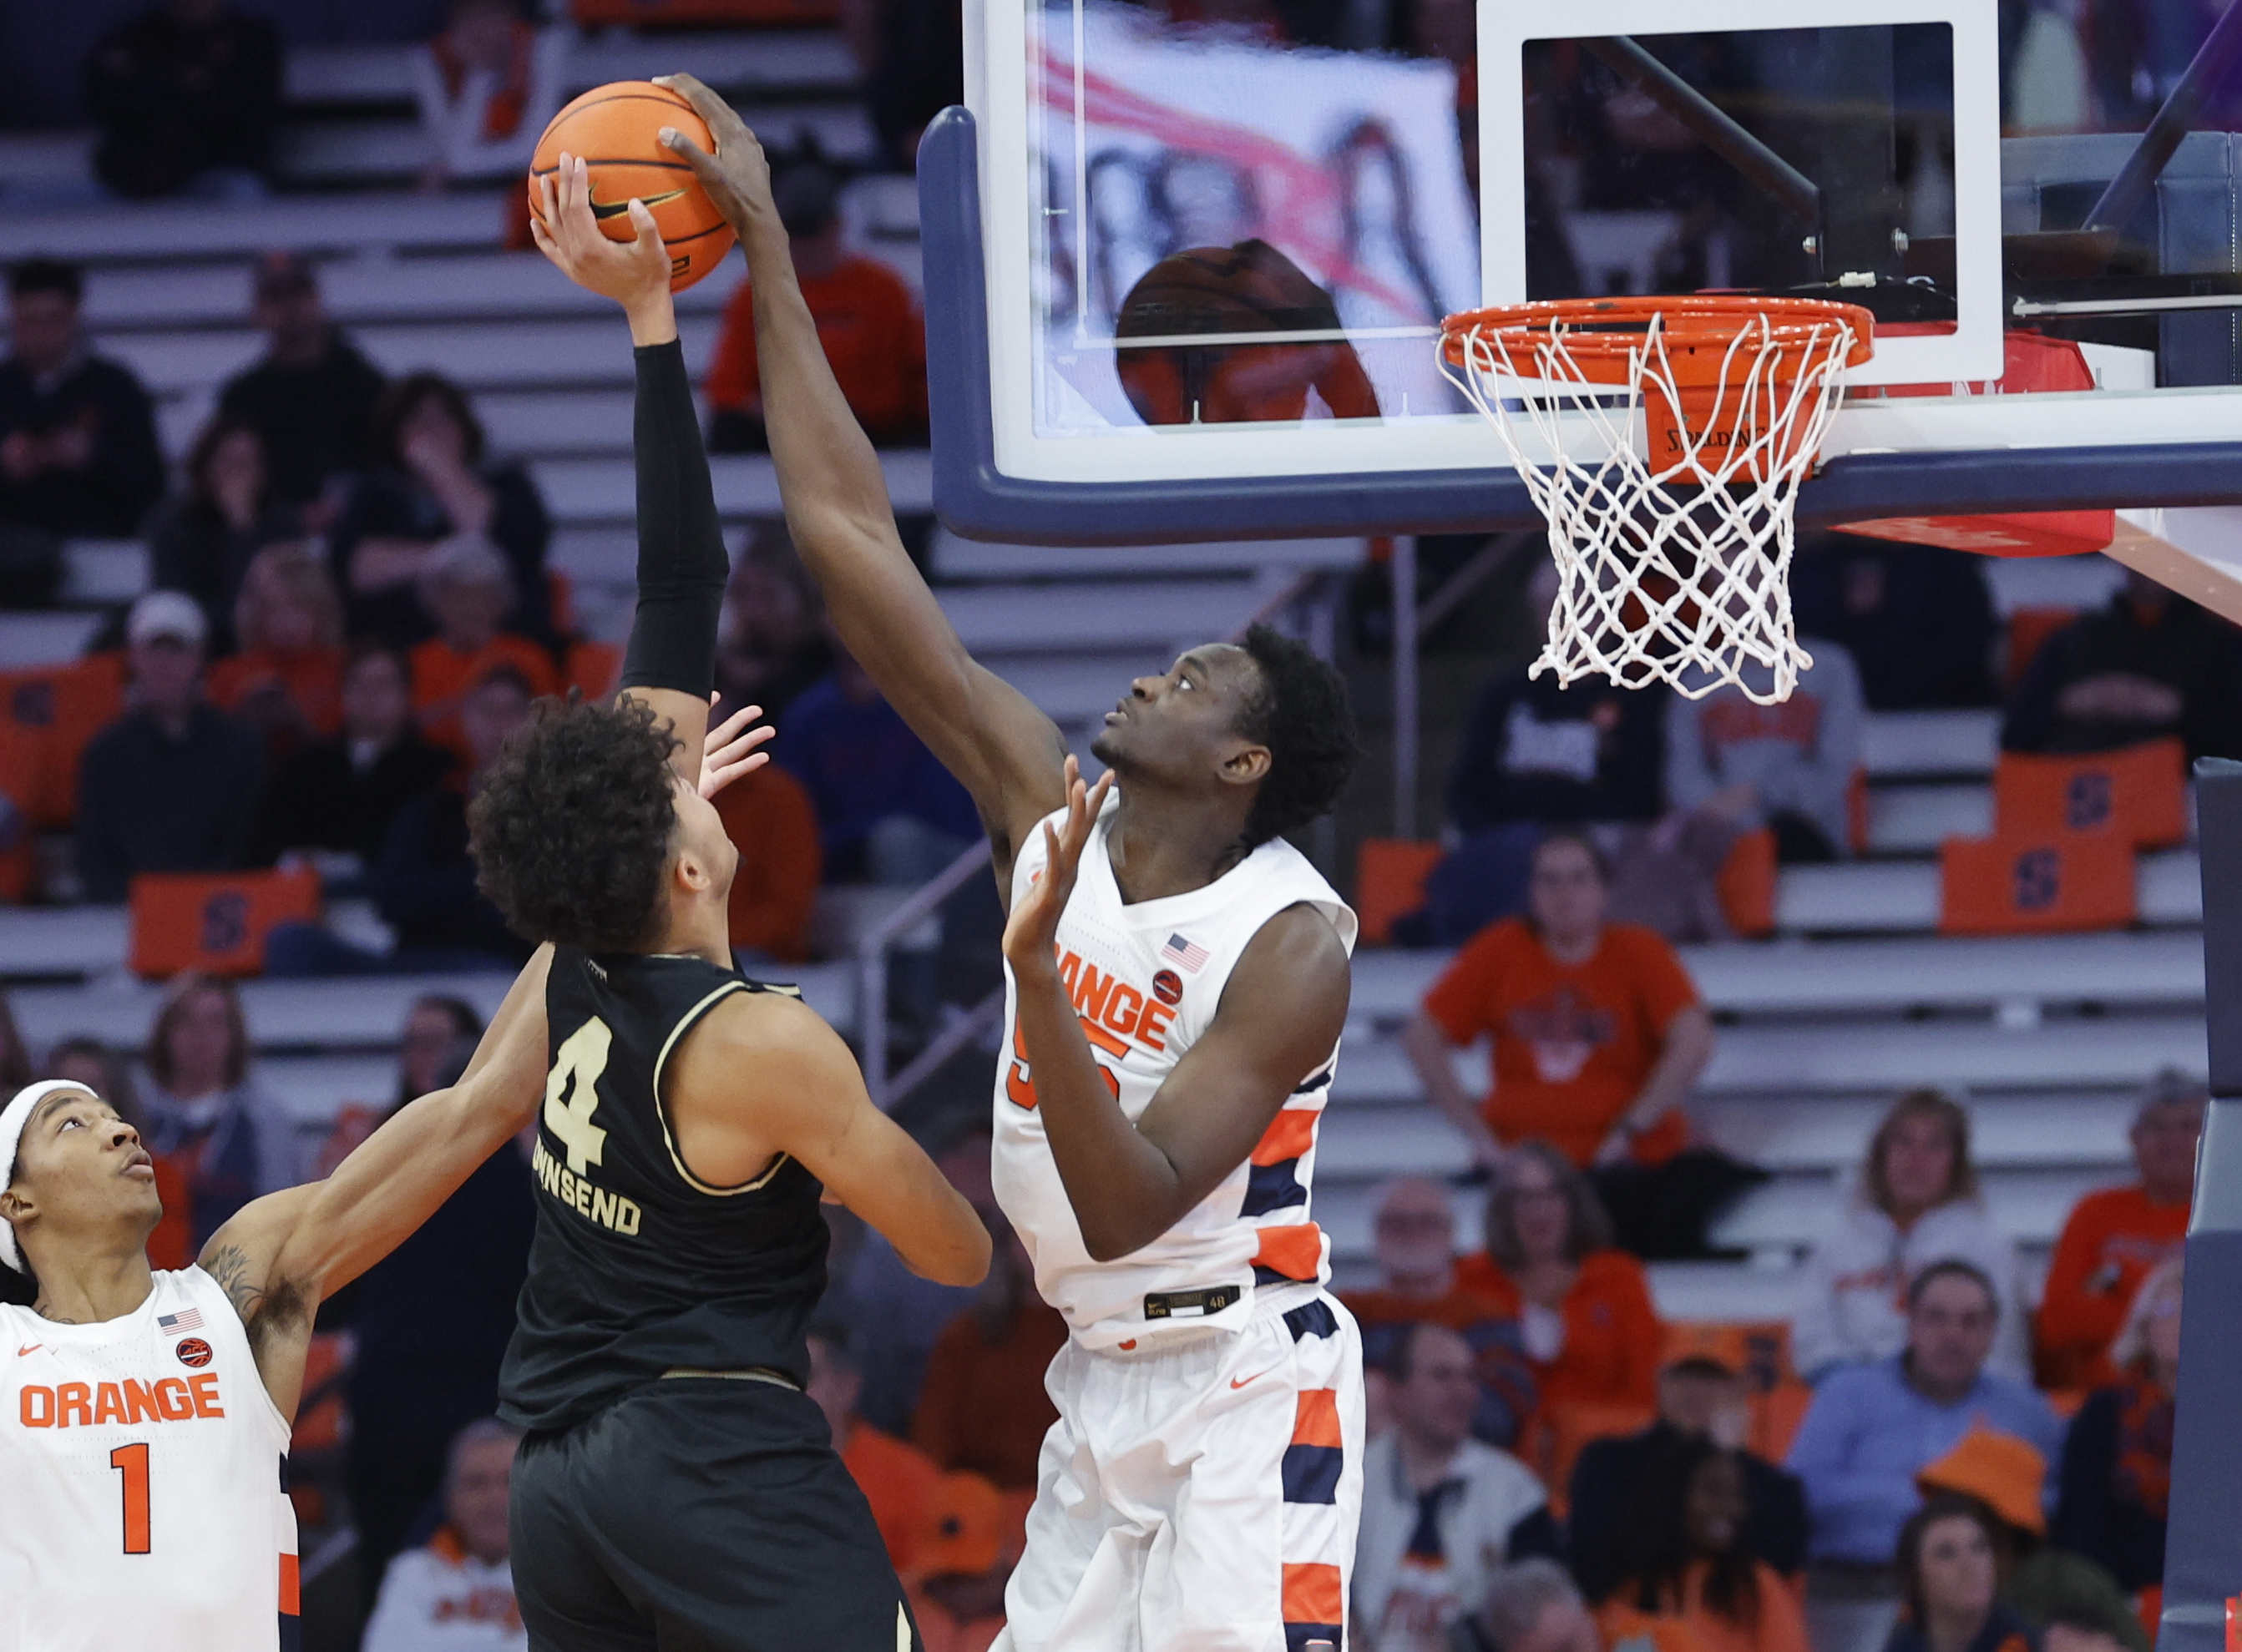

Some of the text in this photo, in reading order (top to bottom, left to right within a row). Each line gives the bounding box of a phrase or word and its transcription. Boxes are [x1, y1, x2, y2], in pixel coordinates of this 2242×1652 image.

[1667, 427, 1769, 452] SPALDNG
[1055, 941, 1178, 1053] ANGE
[544, 1015, 613, 1178] 4
[533, 1133, 641, 1236] OWNSEND
[20, 1372, 225, 1428] ORANGE
[110, 1442, 151, 1554] 1
